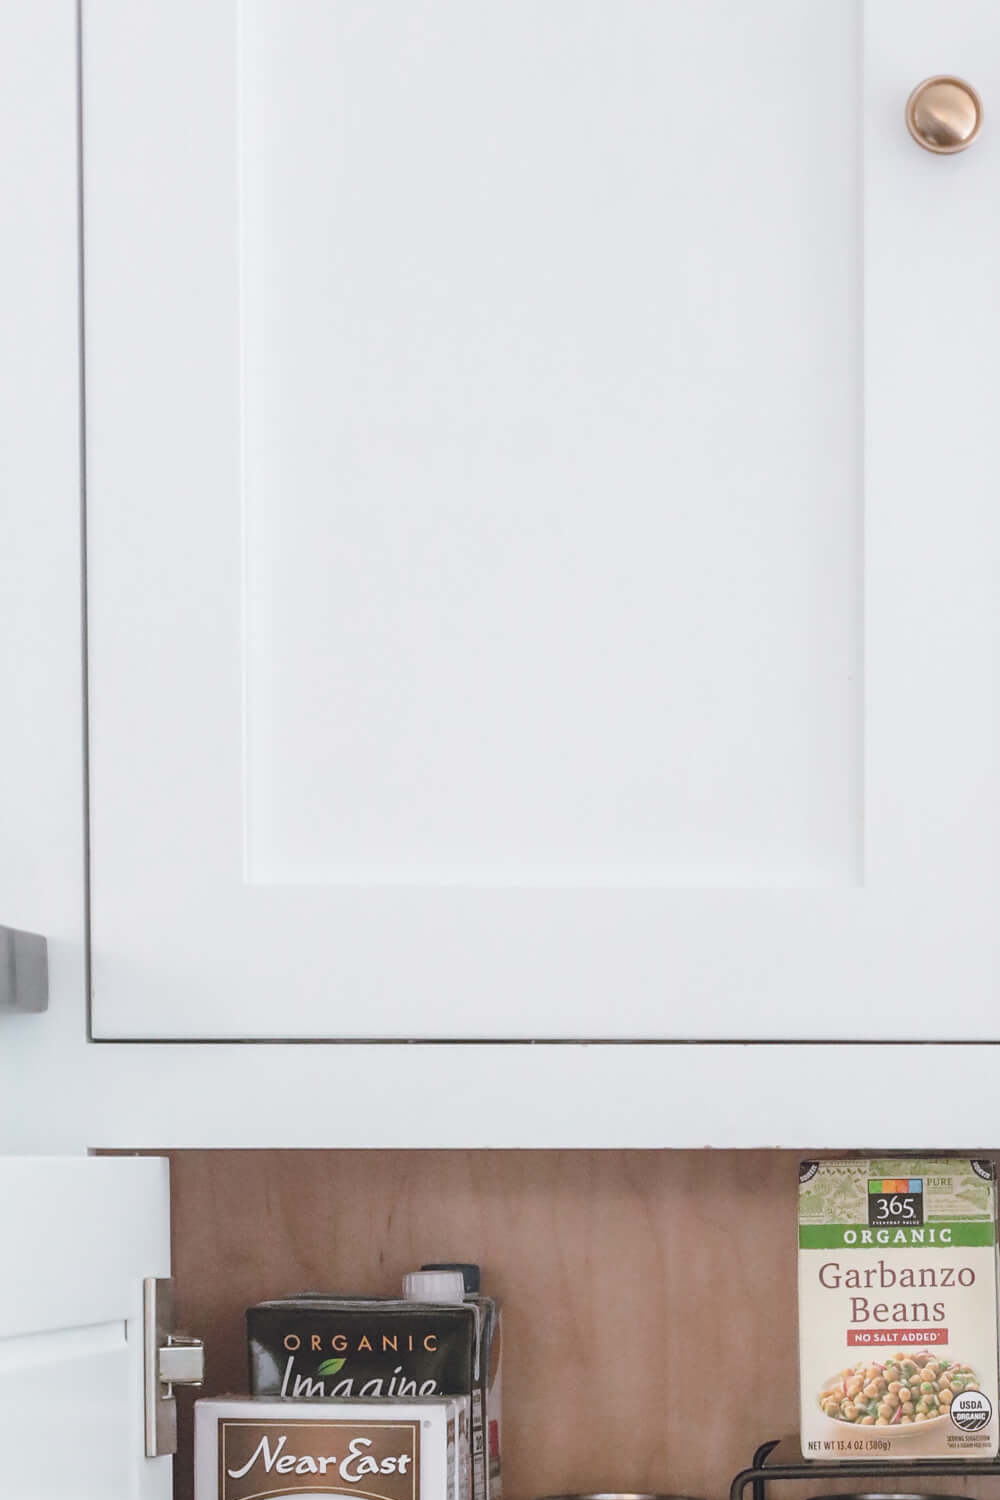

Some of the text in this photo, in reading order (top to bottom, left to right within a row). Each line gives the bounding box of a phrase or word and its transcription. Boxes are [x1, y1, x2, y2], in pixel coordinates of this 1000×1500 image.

[876, 1195, 915, 1219] 365
[843, 1228, 953, 1244] ORGANIC
[818, 1260, 976, 1289] Garbanzo
[850, 1297, 946, 1323] Beans
[283, 1334, 438, 1351] ORGANIC
[855, 1334, 870, 1342] NO
[873, 1334, 898, 1342] SALT
[959, 1400, 983, 1410] USDA
[957, 1411, 986, 1420] ORGANIC
[808, 1441, 821, 1450] NET
[824, 1441, 834, 1450] WT
[854, 1440, 864, 1450] OZ
[227, 1435, 412, 1483] Near East
